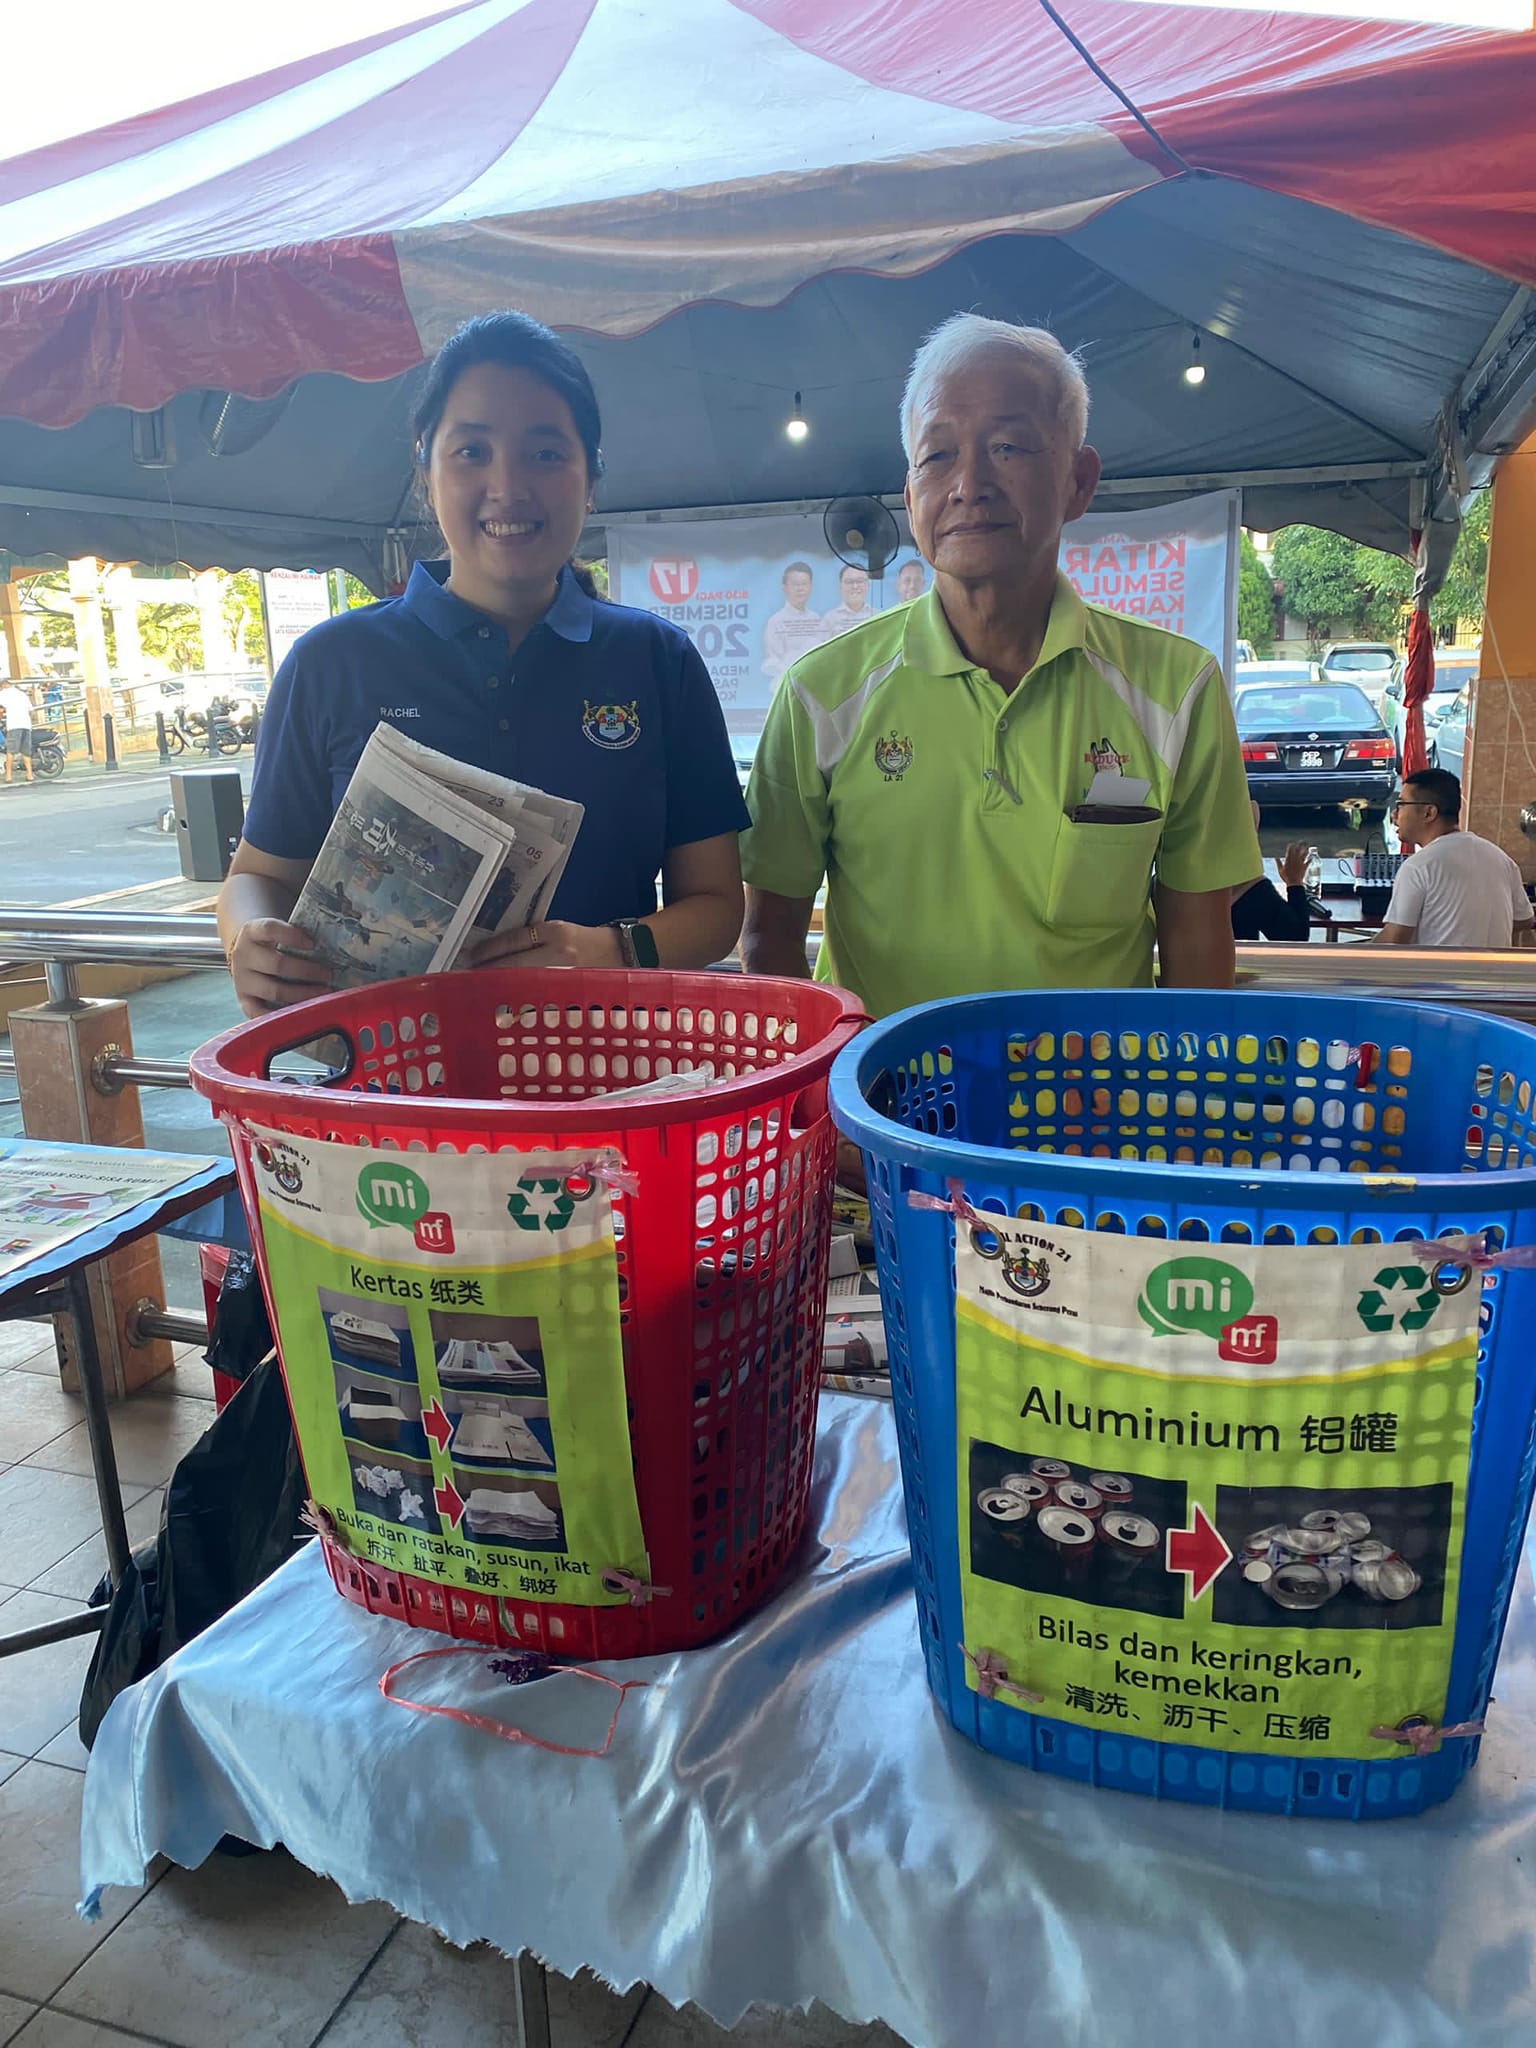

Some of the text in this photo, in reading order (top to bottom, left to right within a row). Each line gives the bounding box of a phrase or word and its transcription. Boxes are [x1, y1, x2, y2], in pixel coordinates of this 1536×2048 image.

[380, 706, 421, 718] RACHEL
[487, 795, 505, 808] 23
[526, 846, 544, 860] 05
[371, 1179, 416, 1210] mi
[420, 1219, 444, 1240] mf
[1015, 1233, 1055, 1252] ACTION
[1055, 1247, 1072, 1262] 21
[351, 1265, 485, 1306] Kertas 纸类
[1167, 1277, 1231, 1312] mi
[1231, 1323, 1268, 1348] mf
[1019, 1386, 1399, 1454] Aluminium 铝罐
[336, 1507, 591, 1576] Buka dan ratakan, susun, ikat
[1038, 1614, 1362, 1679] Bilas dan keringkan,
[1114, 1660, 1279, 1703] kemekkan
